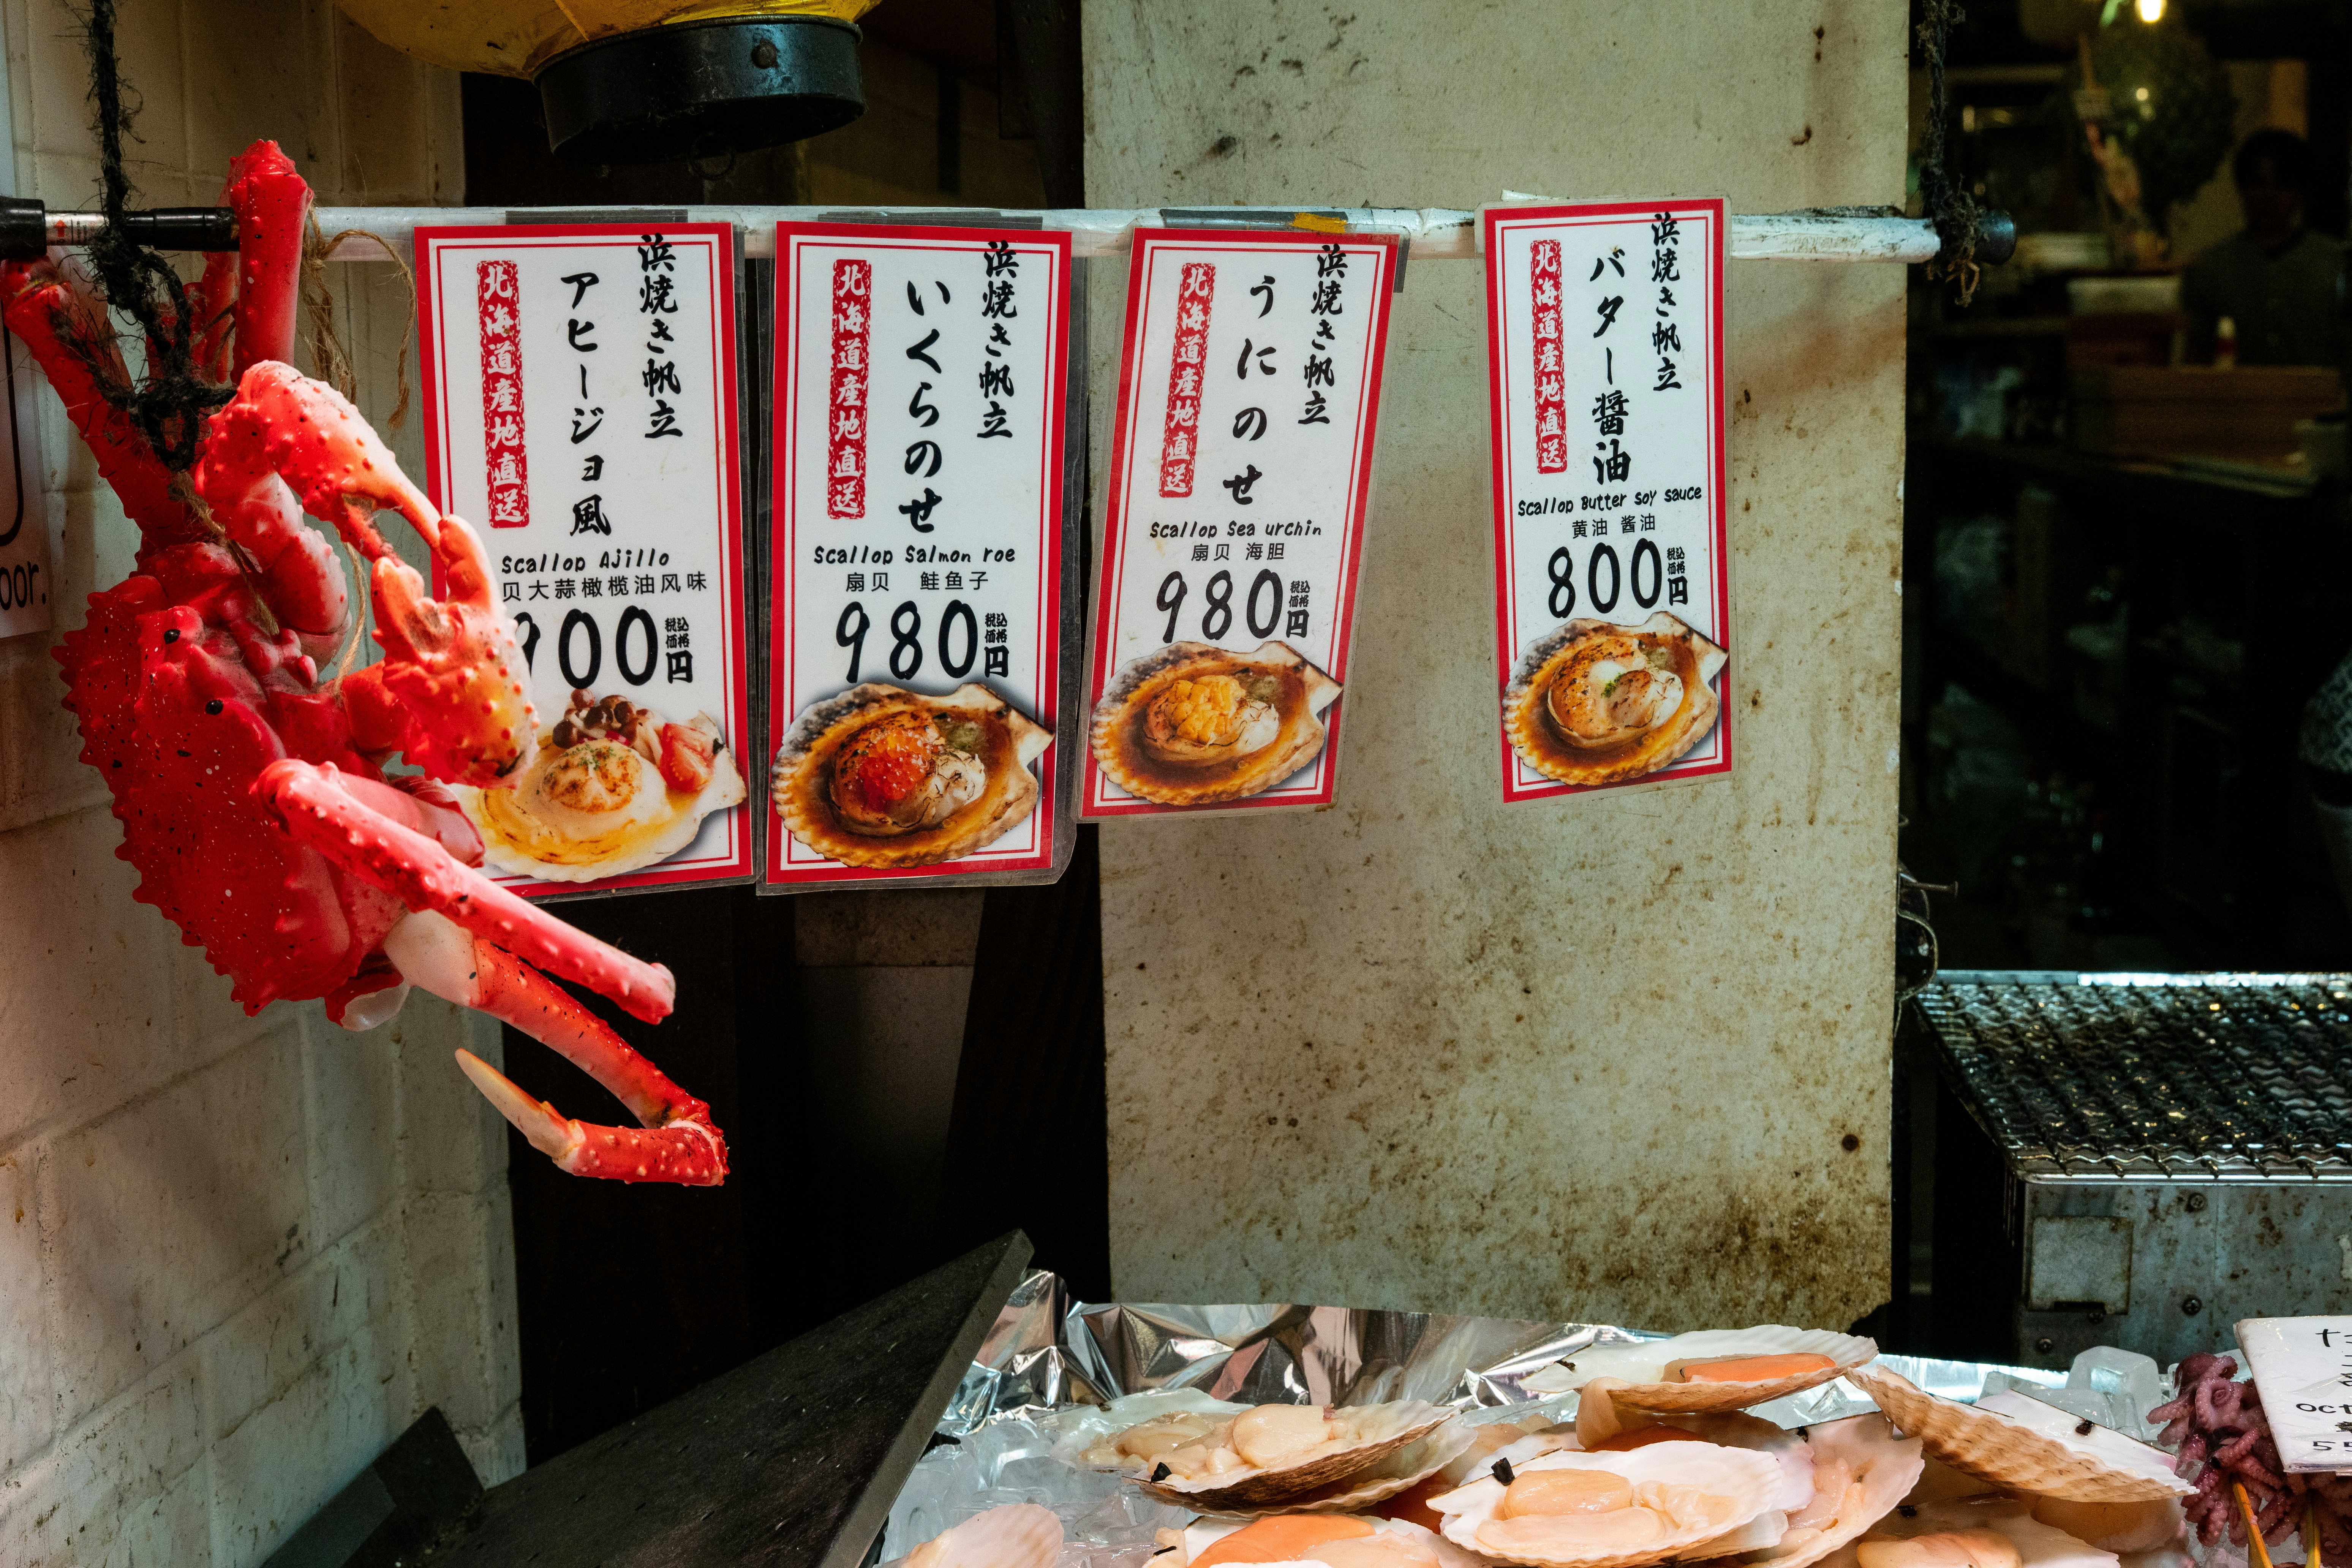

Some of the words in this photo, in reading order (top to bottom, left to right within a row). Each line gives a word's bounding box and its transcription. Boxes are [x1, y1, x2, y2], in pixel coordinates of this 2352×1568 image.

[484, 265, 524, 524] 北海道産地直送
[638, 232, 683, 438] 浜焼き帆立
[834, 264, 865, 514] 北海道産地直送
[977, 240, 1019, 438] 浜焼き帆立
[1165, 268, 1209, 493] 北海道産地直送
[1223, 275, 1276, 505] うにのせ
[1298, 243, 1348, 424] 浜焼き帆立
[1535, 245, 1563, 469] 北海道産地直送
[1590, 249, 1631, 485] バター醤油
[1652, 212, 1682, 391] 浜焼き帆立
[561, 272, 611, 536] アヒージョ風
[899, 281, 950, 533] いくらのせ
[502, 555, 585, 574] Scallop
[599, 548, 669, 568] Ajillo
[503, 571, 707, 602] 贝大蒜橄榄油风味
[814, 545, 893, 565] Scallop
[905, 545, 971, 563] Salmon
[983, 548, 1015, 562] roe
[846, 572, 889, 591] 扇贝
[920, 571, 988, 590] 鲑鱼子
[1150, 521, 1217, 538] Scallop
[1227, 520, 1255, 536] Sea
[1266, 520, 1321, 536] urchin
[1191, 544, 1229, 561] 扇贝
[1246, 542, 1284, 560] 海胆
[1518, 498, 1573, 516] Scallop
[1581, 493, 1627, 511] Butter
[1634, 490, 1657, 506] soy
[1664, 487, 1701, 502] sauce
[1572, 518, 1607, 539] 黄油
[1621, 513, 1655, 534] 酱油
